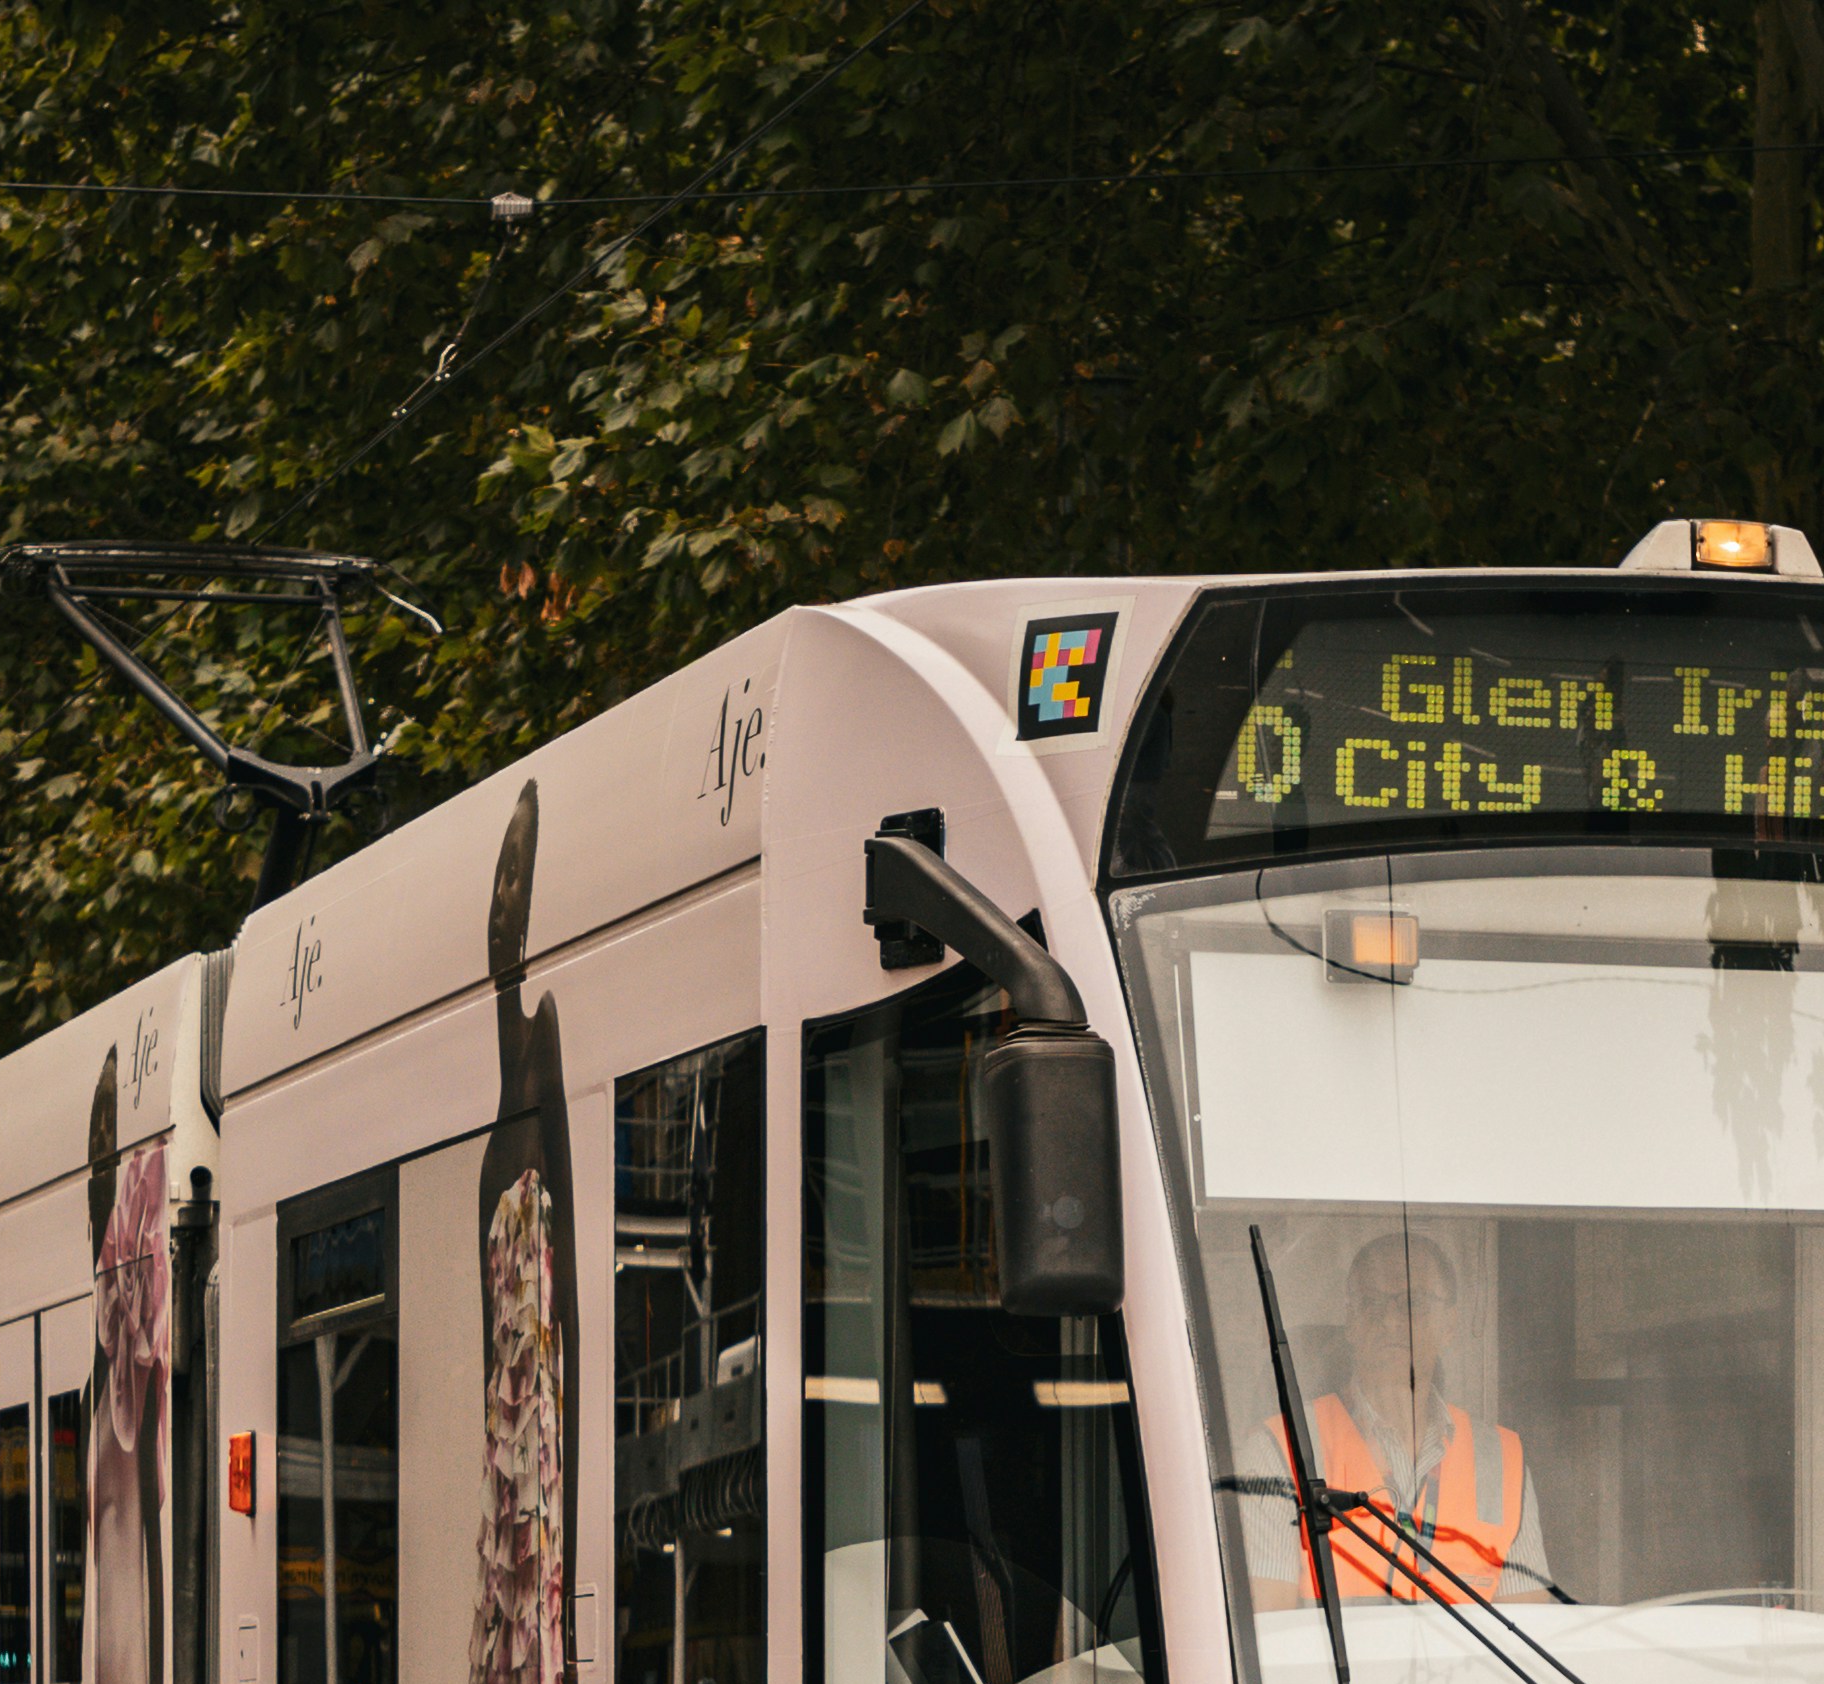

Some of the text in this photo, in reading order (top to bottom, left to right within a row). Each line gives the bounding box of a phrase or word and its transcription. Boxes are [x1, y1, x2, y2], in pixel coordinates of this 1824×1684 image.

[1382, 654, 1614, 730] Glen
[697, 678, 765, 827] Aje.
[1336, 738, 1542, 812] City
[1602, 750, 1664, 811] &
[280, 914, 323, 1031] Aje.
[123, 1007, 159, 1110] Aje.
